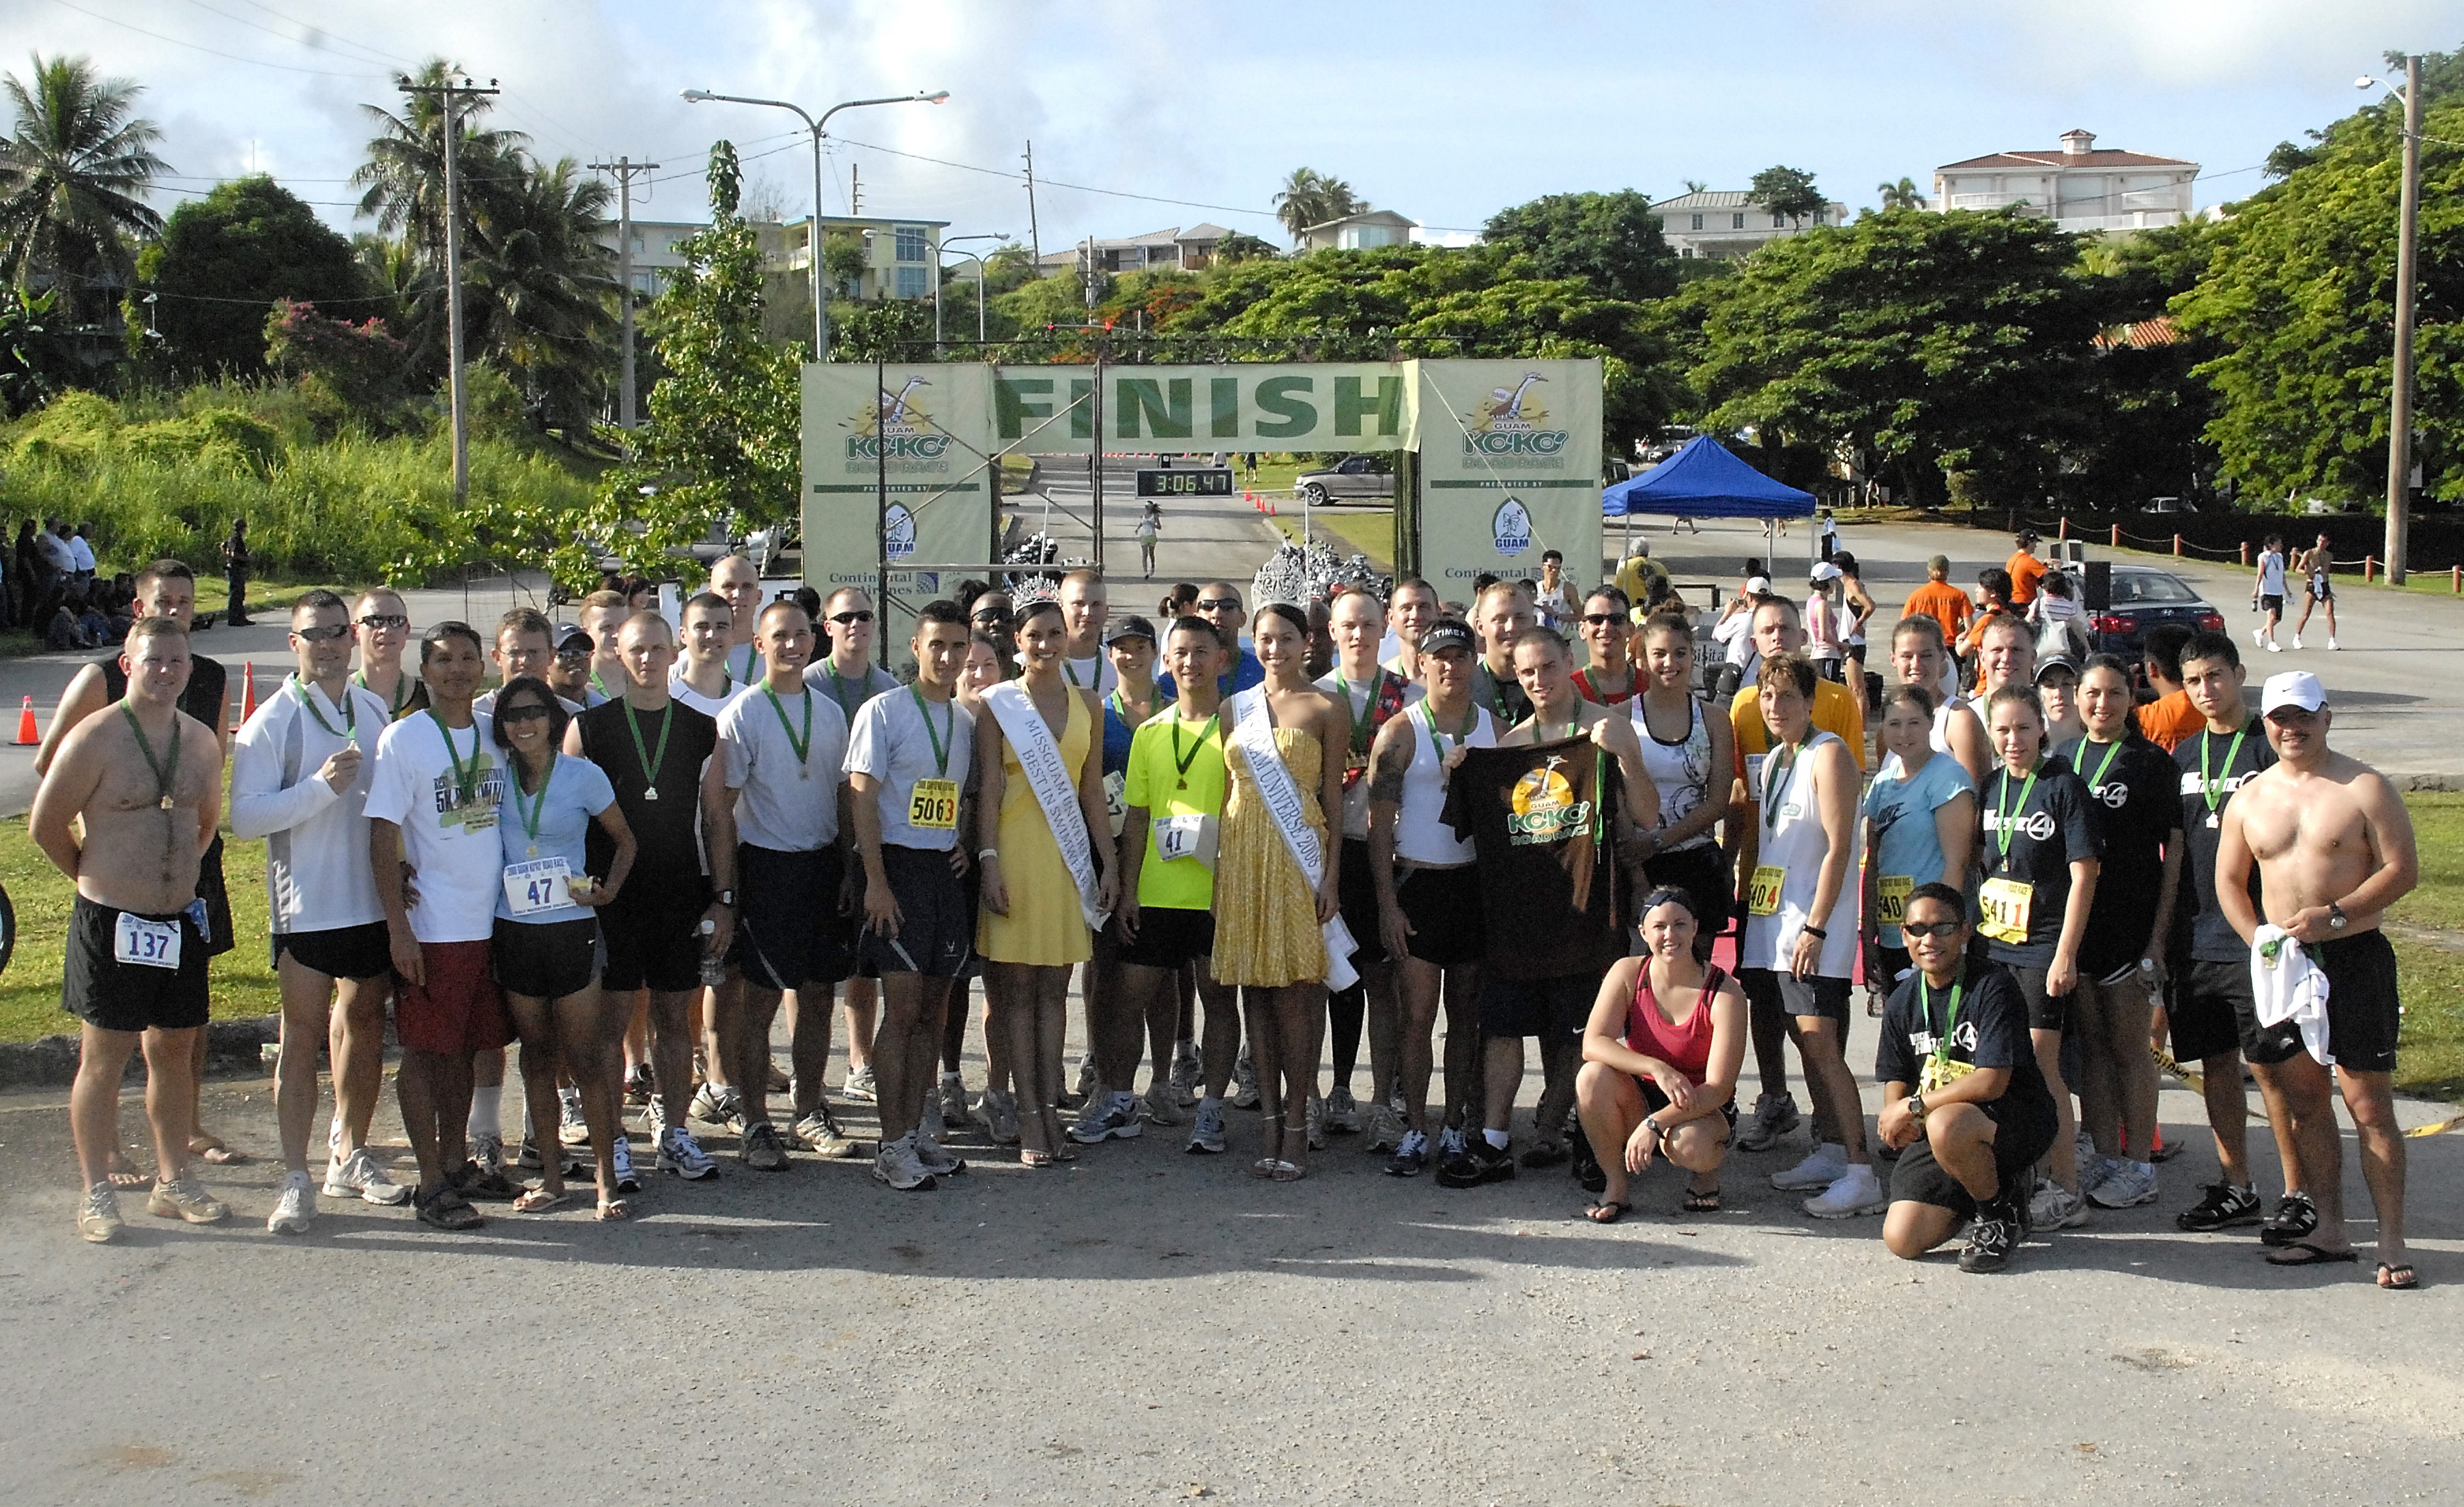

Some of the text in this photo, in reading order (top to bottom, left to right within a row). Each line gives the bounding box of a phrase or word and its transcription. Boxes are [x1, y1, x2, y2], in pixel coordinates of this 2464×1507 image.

[995, 376, 1403, 439] FINISH
[1463, 431, 1568, 455] KO'KO'
[900, 461, 949, 473] RACE
[1463, 457, 1564, 469] ROAD RACE
[887, 543, 914, 552] UAM
[1495, 539, 1530, 548] GUAM
[829, 572, 912, 583] Contintal
[1445, 568, 1527, 578] Continental
[1434, 628, 1466, 638] TIMEX
[1022, 749, 1048, 785] BEST
[1042, 788, 1056, 805] IN
[913, 796, 955, 822] 5063
[1259, 766, 1309, 839] UNIVERSE
[1297, 834, 1321, 867] 2008
[1530, 800, 1560, 809] GUAM
[1166, 829, 1183, 853] 41
[1510, 824, 1590, 846] ROAD RACE
[528, 878, 552, 905] 47
[1751, 883, 1777, 908] 404
[1878, 894, 1909, 919] 540
[1982, 895, 2021, 928] 5411
[129, 930, 169, 959] 137
[2150, 1048, 2190, 1079] CAUTIO
